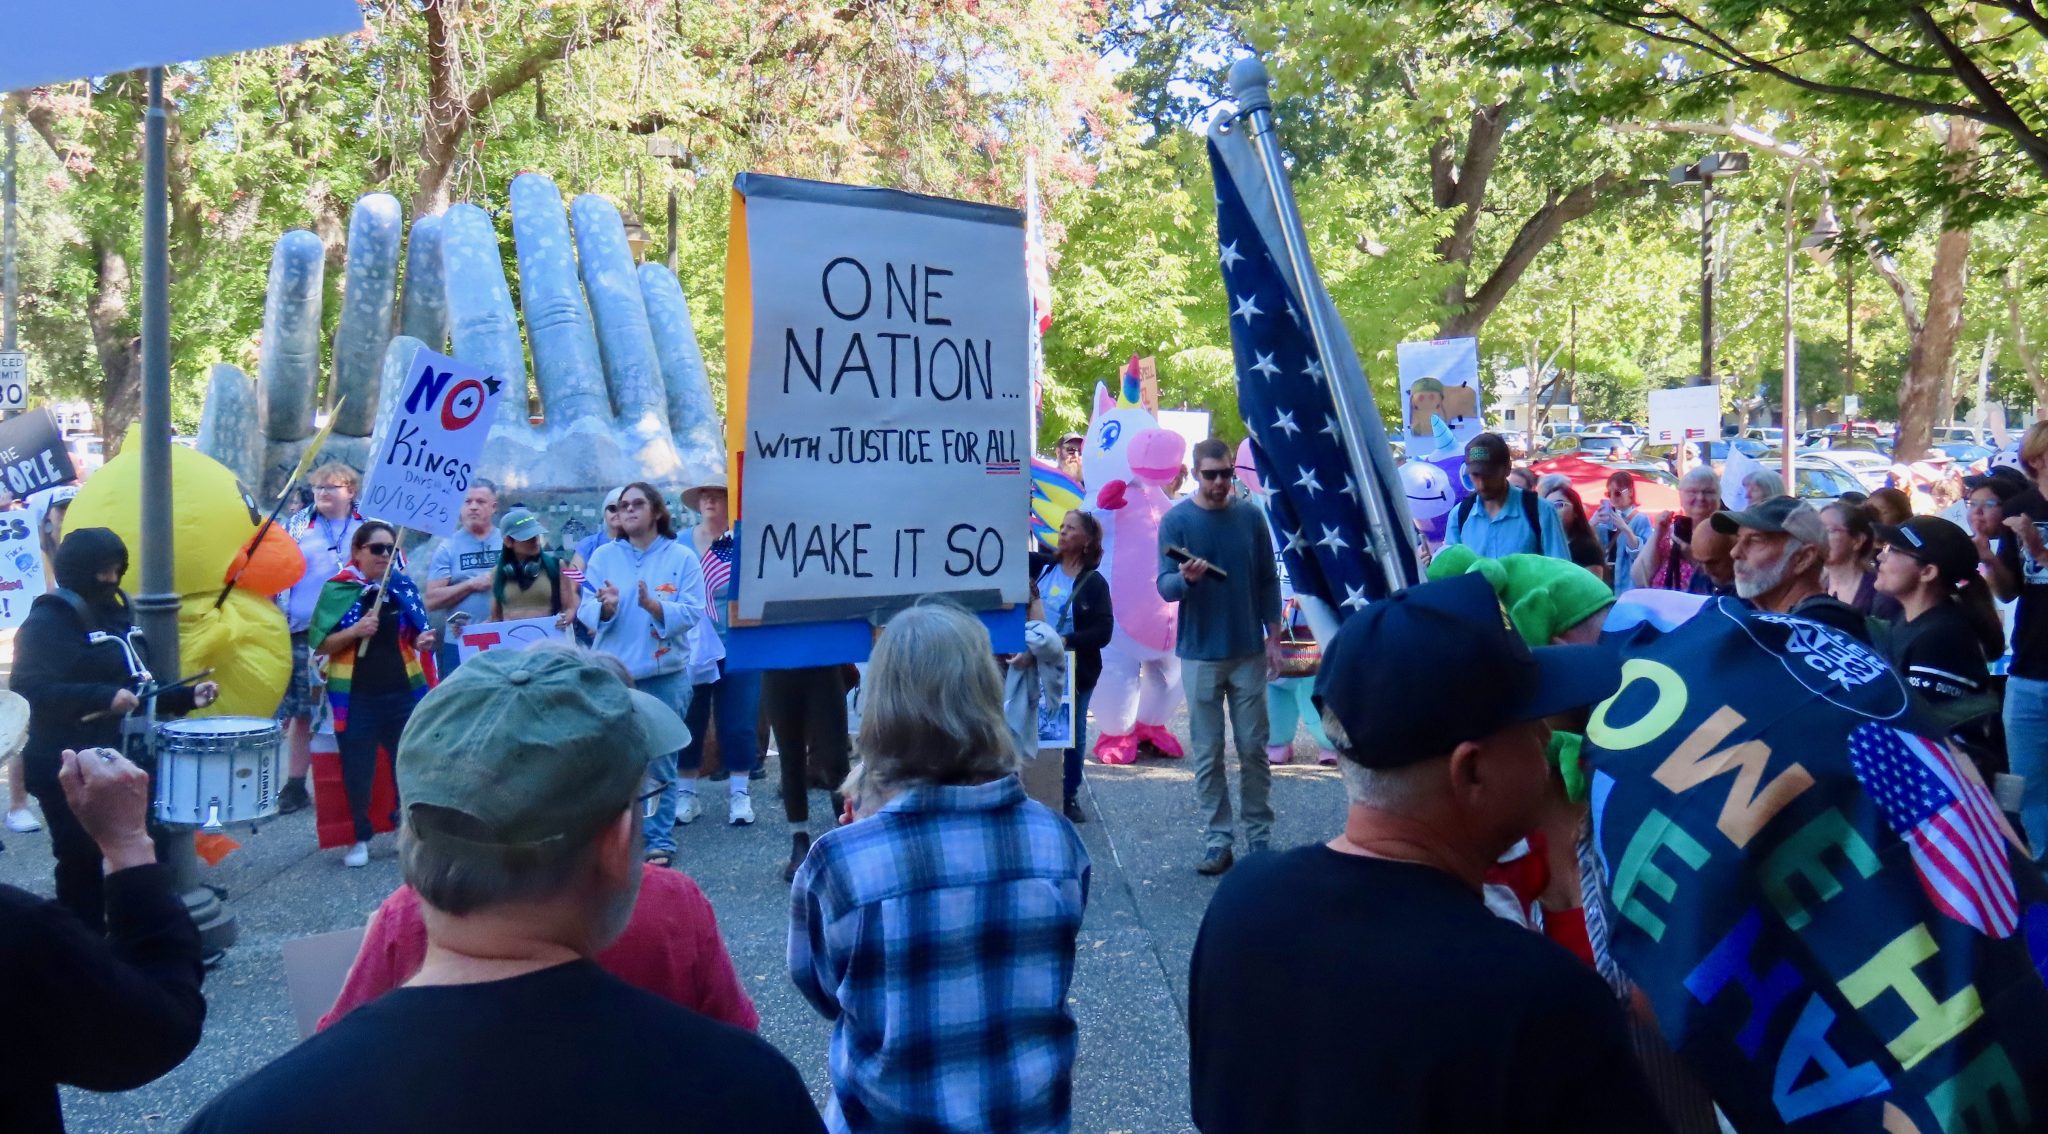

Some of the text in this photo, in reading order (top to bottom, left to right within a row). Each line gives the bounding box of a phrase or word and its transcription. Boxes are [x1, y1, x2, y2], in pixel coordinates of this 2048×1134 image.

[822, 257, 953, 325] ONE
[0, 358, 23, 367] EED
[405, 365, 485, 431] NO
[754, 427, 1021, 464] WITH JUSTICE FOR ALL
[367, 485, 449, 523] 10/18/25
[758, 522, 1004, 579] MAKE IT SO
